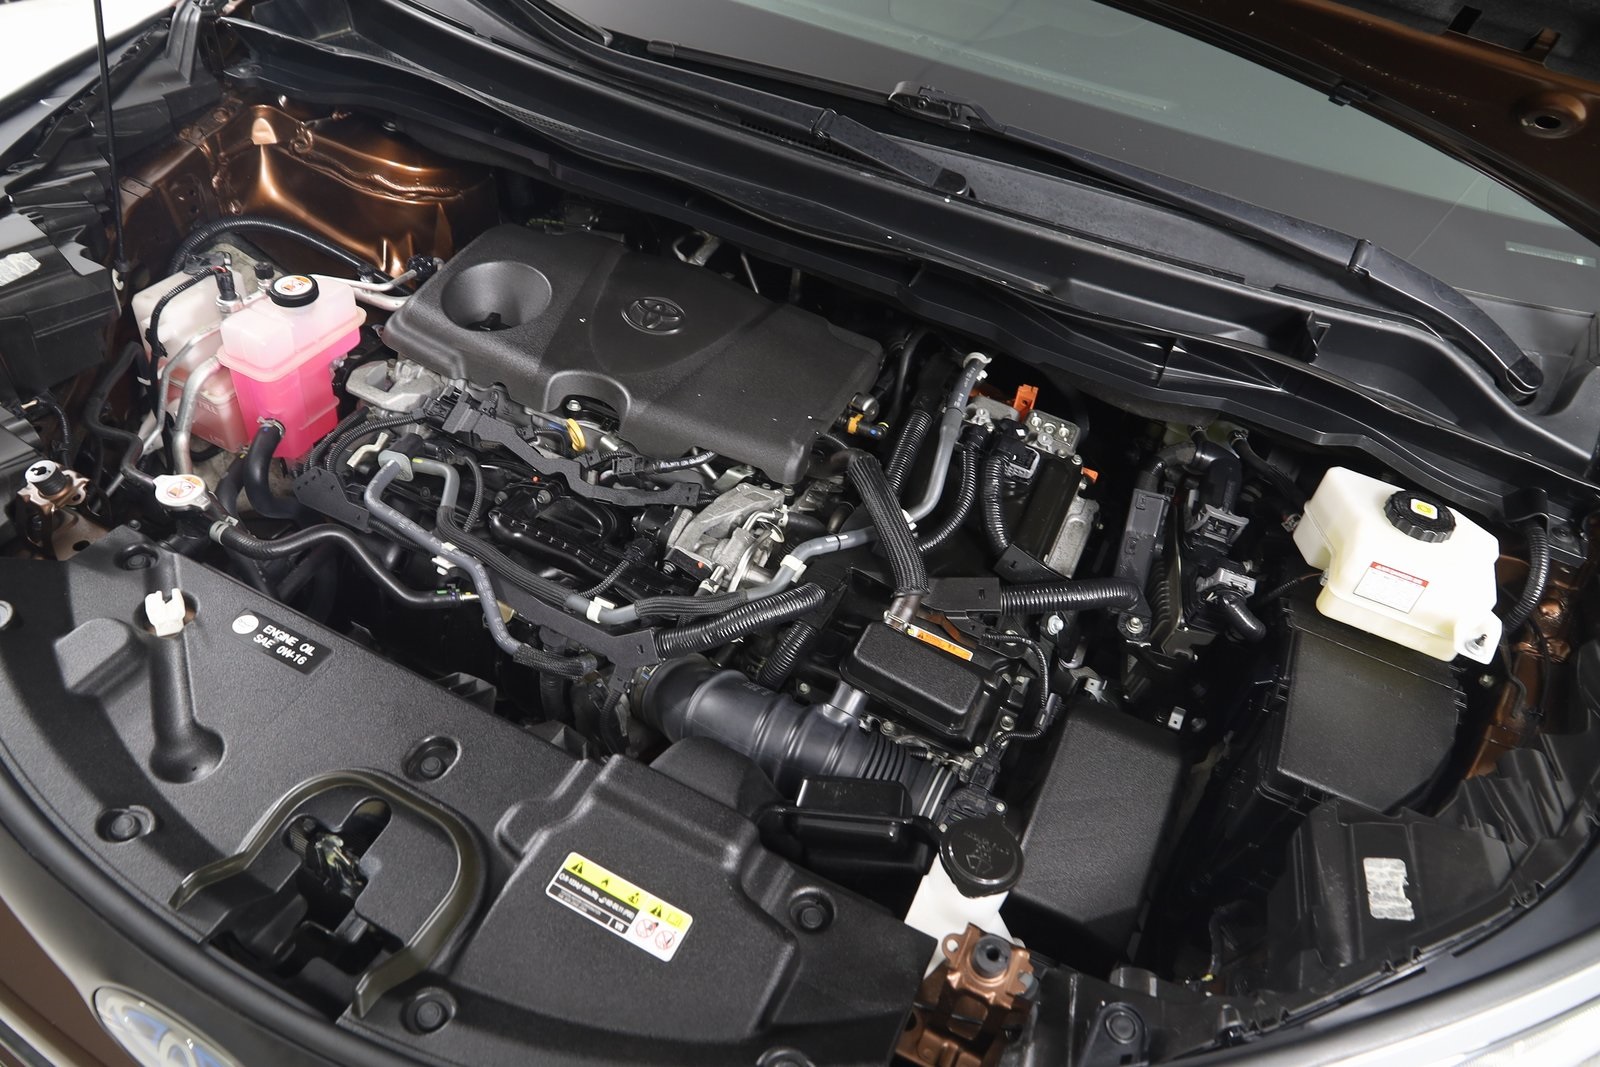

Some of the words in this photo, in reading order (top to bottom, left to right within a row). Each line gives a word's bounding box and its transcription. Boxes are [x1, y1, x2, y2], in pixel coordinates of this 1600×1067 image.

[253, 633, 276, 649] SAE
[276, 645, 308, 665] 0W-16
[262, 624, 300, 647] ENGINE
[299, 643, 316, 657] OIL
